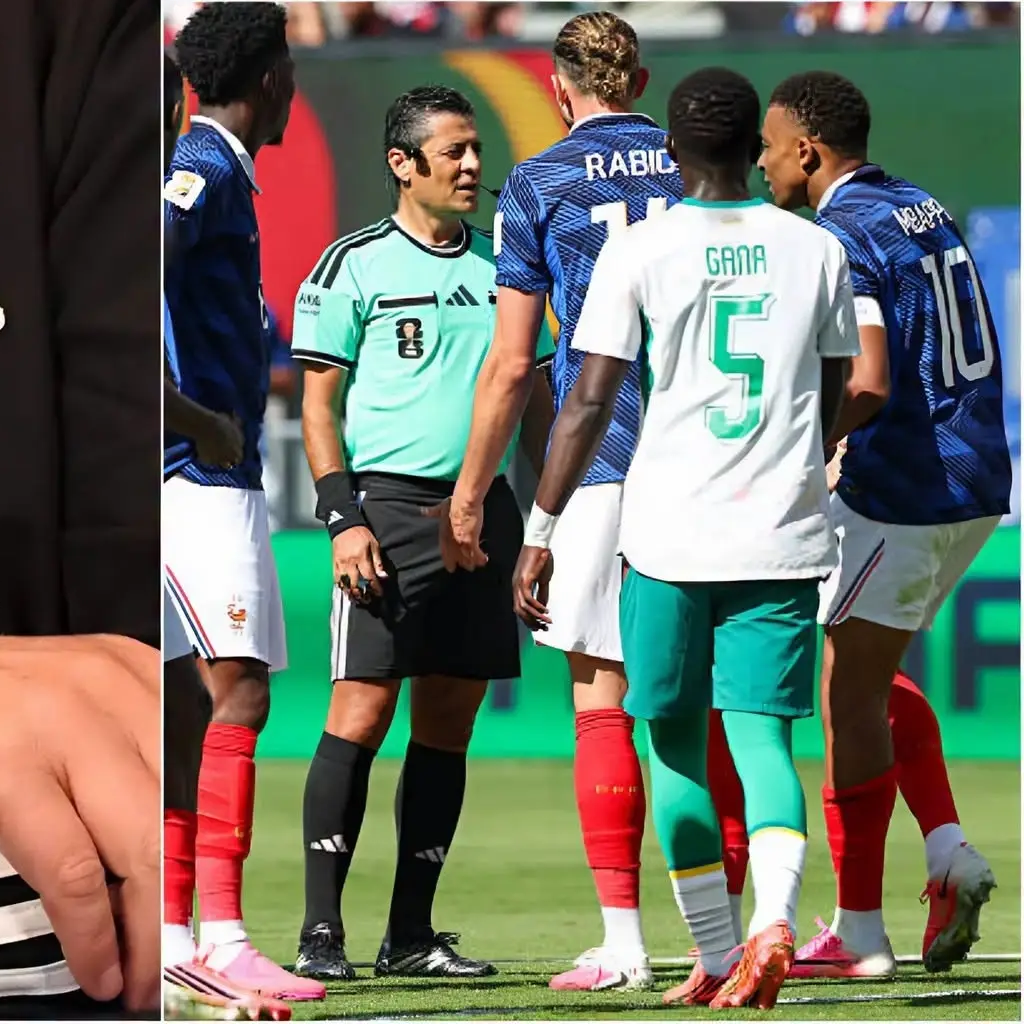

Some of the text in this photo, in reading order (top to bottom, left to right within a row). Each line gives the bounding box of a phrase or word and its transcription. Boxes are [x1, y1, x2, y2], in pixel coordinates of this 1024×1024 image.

[706, 244, 767, 276] GANA
[919, 245, 995, 388] 10
[705, 293, 777, 442] 5
